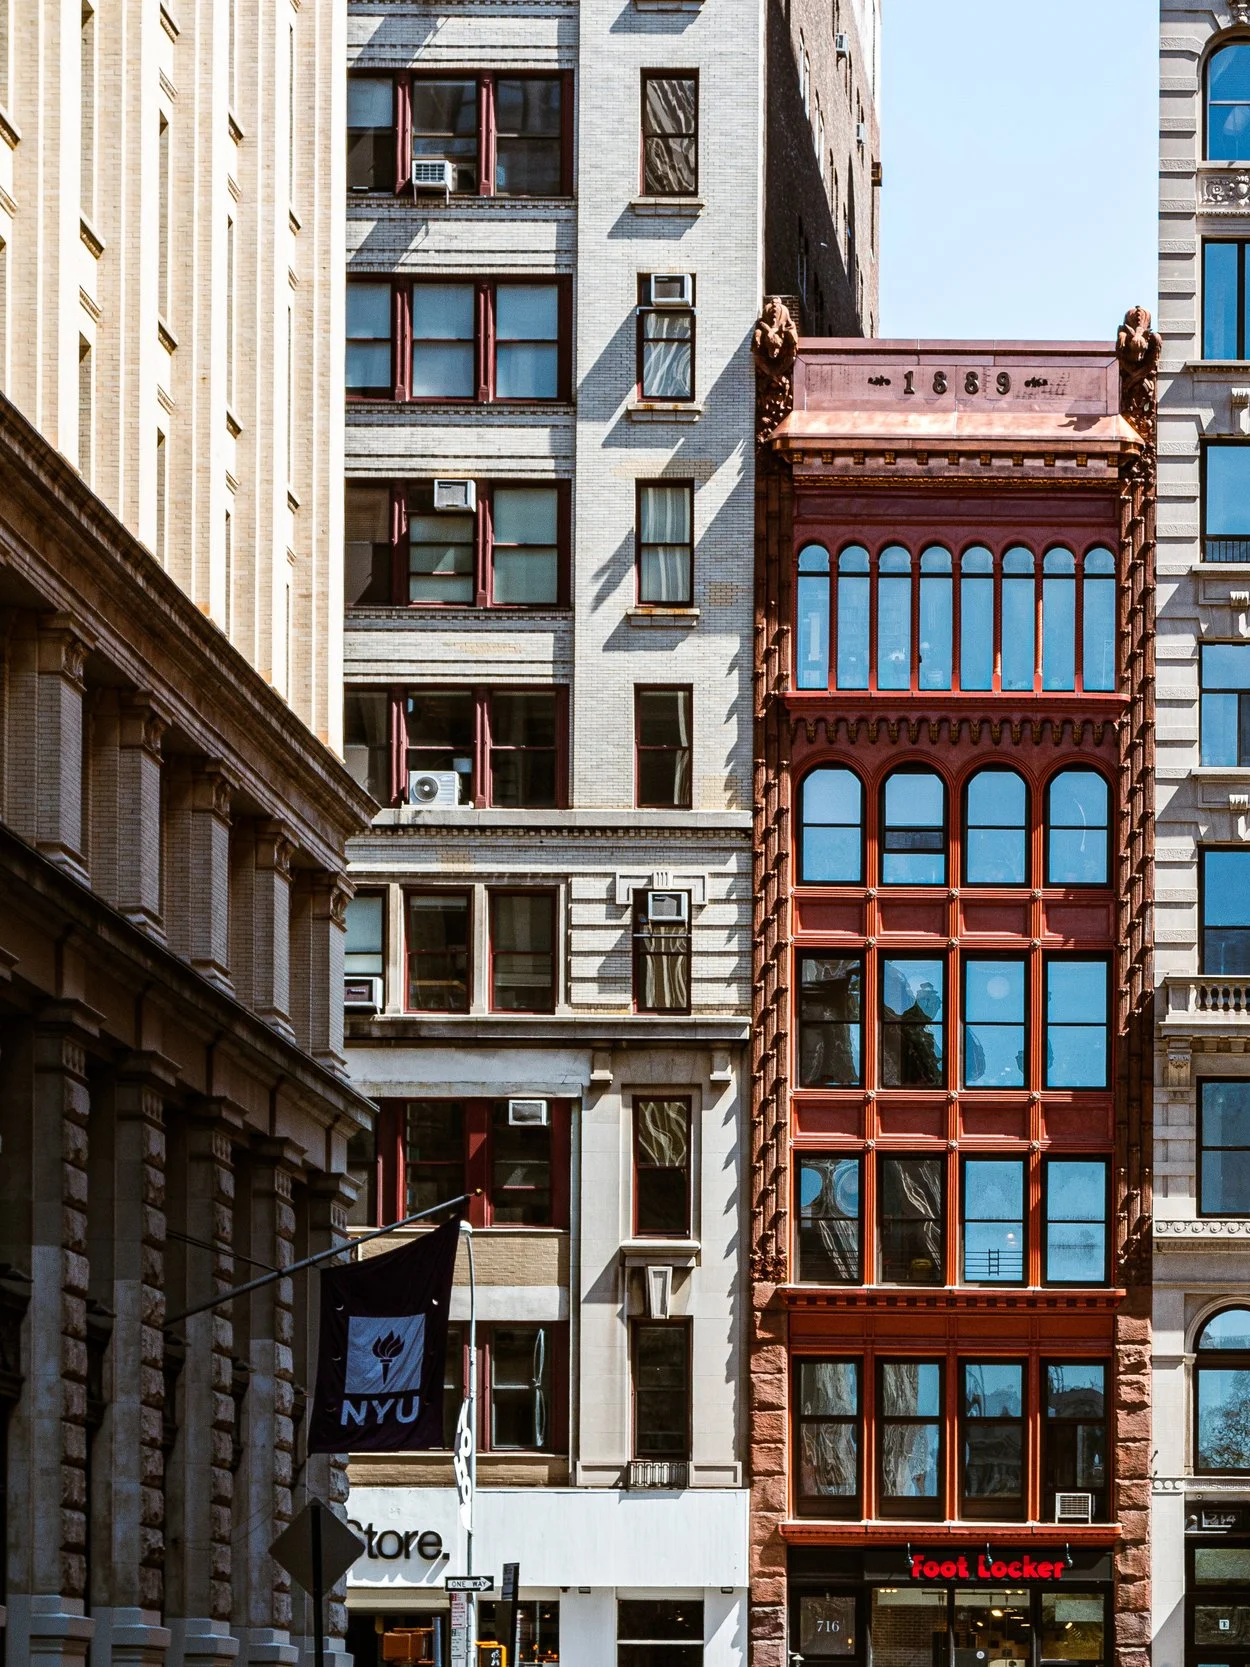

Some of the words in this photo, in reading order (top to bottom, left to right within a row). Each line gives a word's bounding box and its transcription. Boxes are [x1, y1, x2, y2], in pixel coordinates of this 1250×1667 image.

[904, 370, 1011, 395] 1889
[340, 1396, 420, 1426] NYU
[912, 1555, 968, 1578] Foot
[978, 1555, 1065, 1578] Locker
[816, 1619, 840, 1633] 716
